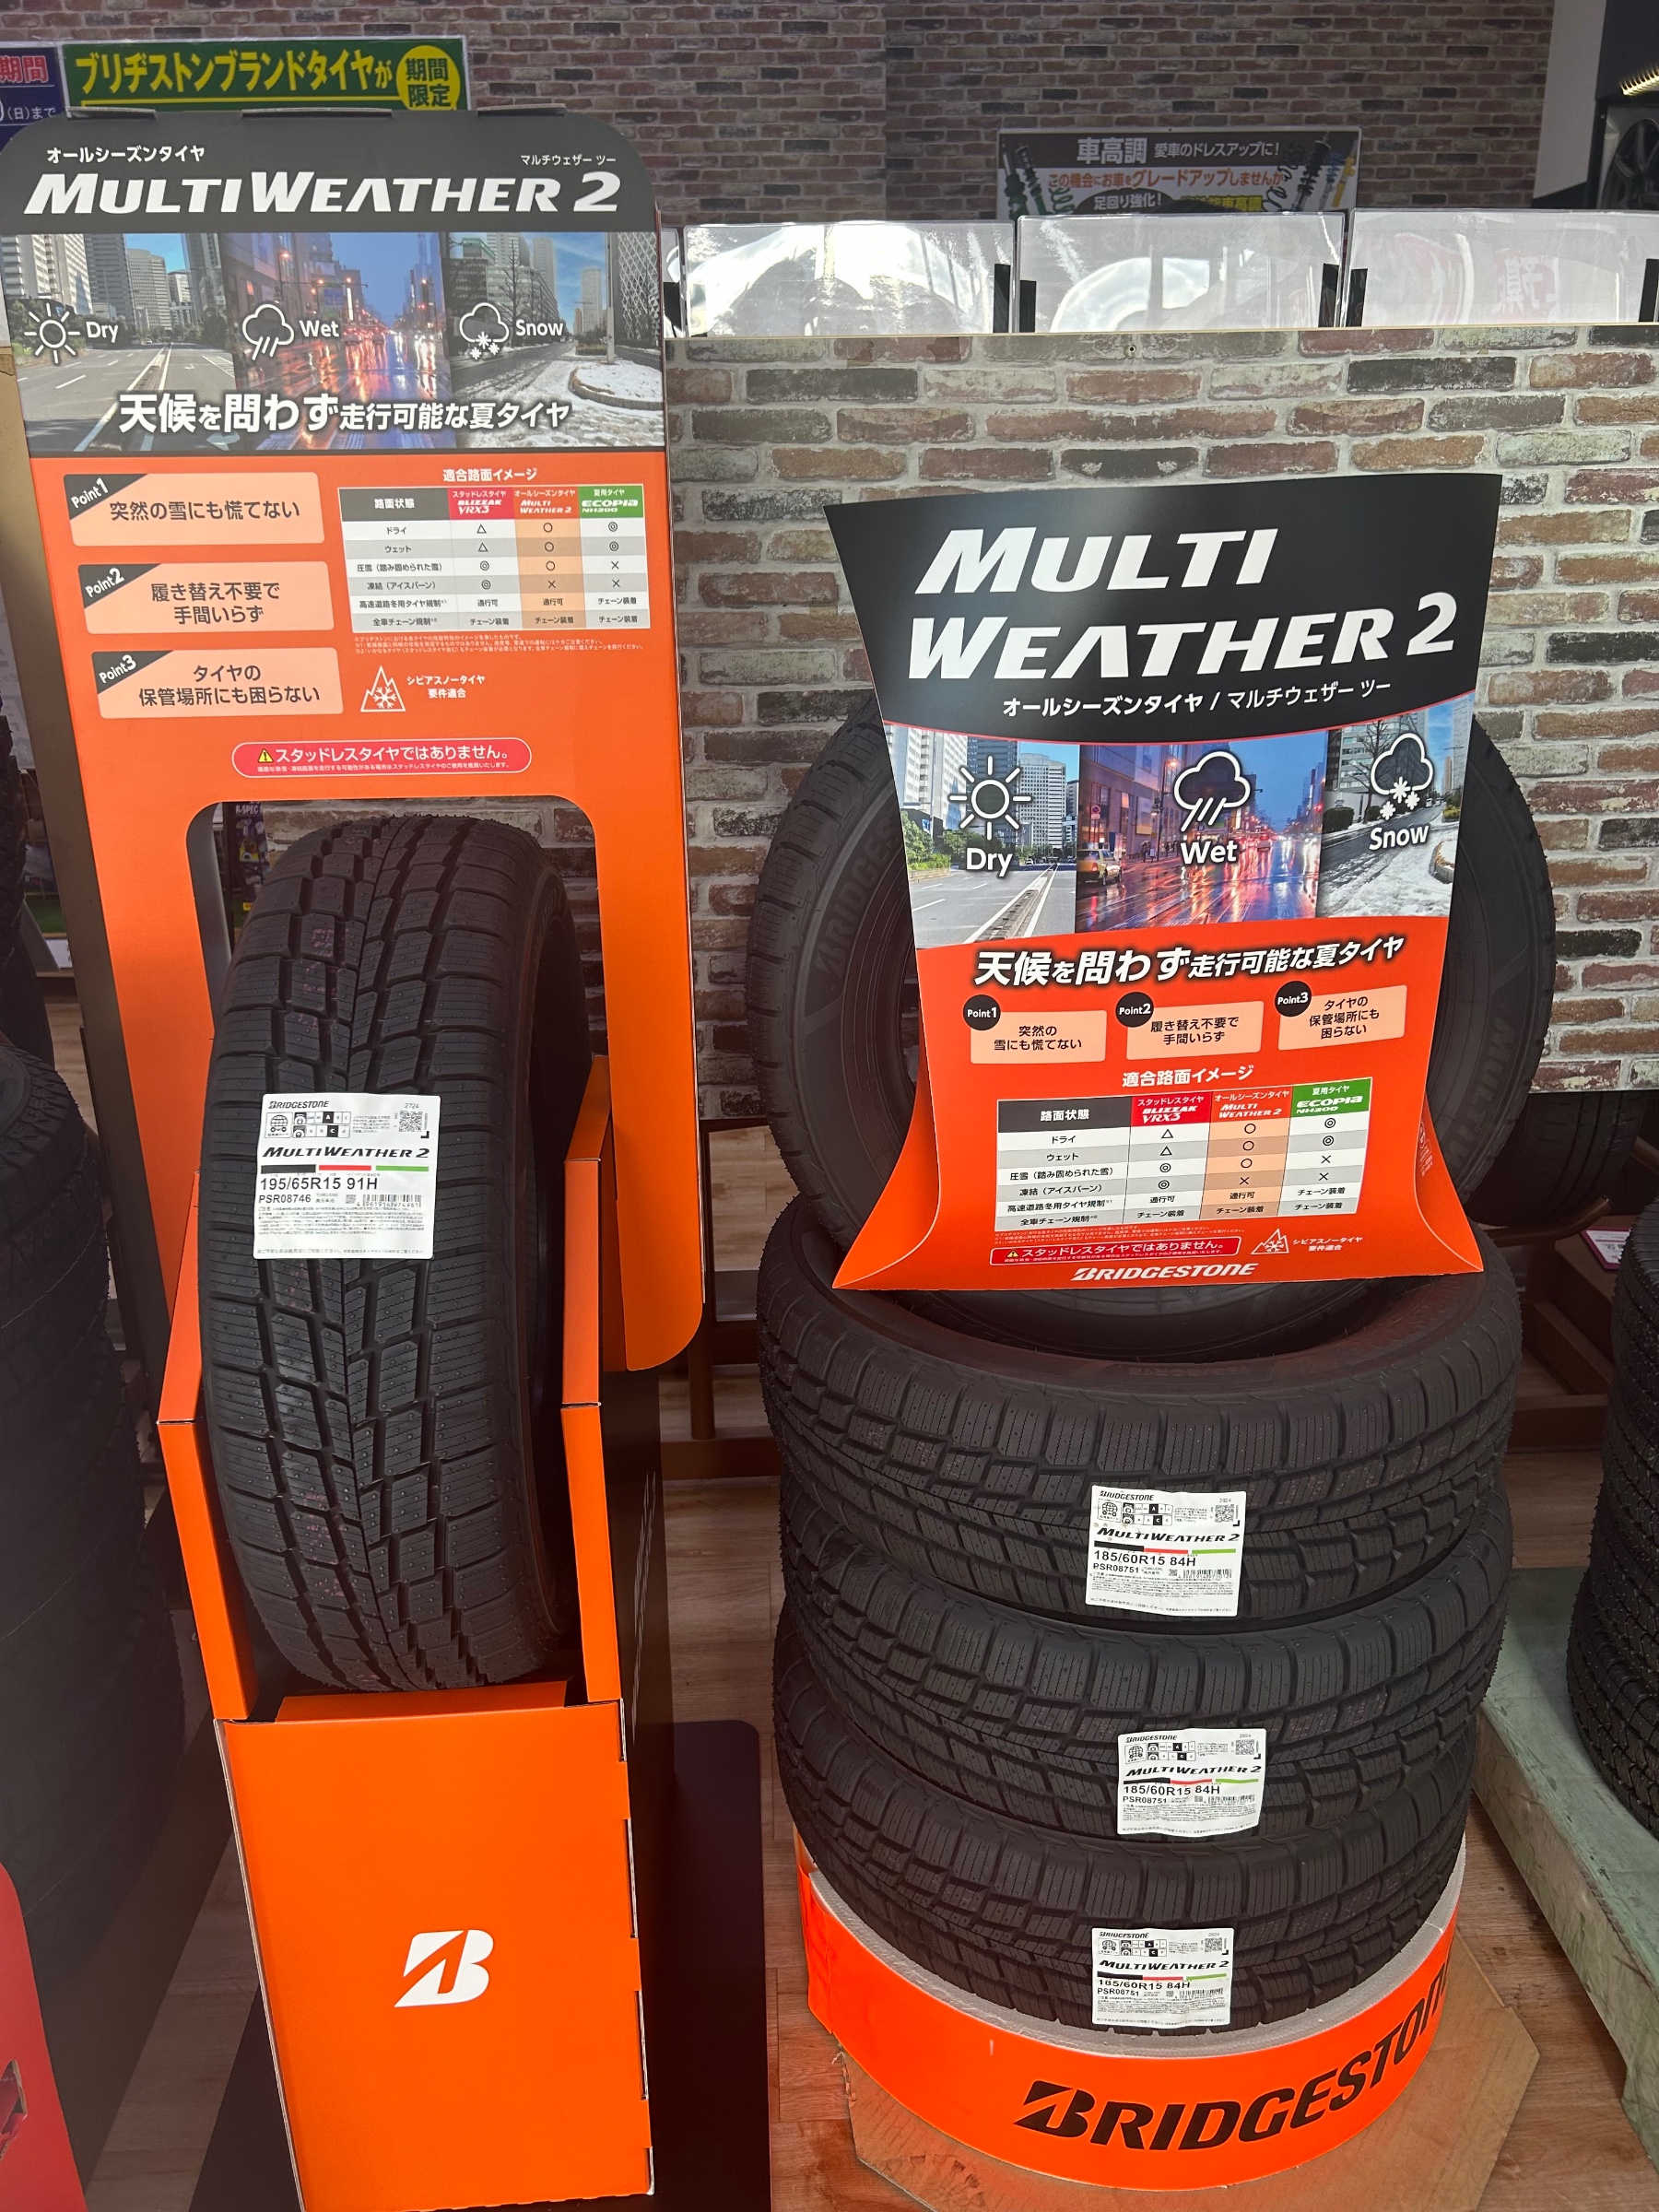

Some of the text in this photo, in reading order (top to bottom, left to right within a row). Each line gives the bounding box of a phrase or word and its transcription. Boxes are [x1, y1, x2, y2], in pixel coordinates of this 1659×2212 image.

[0, 55, 49, 83] 期間
[76, 49, 393, 94] ブリヂストンブランドタイヤが
[406, 58, 449, 81] 期間
[407, 84, 451, 108] 限定
[47, 145, 205, 163] オールシーズンタイヤ
[1077, 136, 1147, 164] 車高調
[520, 153, 617, 167] マルチウェザー ツー
[574, 171, 621, 215] 2
[86, 320, 120, 345] Dry
[300, 320, 340, 339] Wet
[515, 320, 564, 338] Snow
[118, 394, 571, 435] 天候を問わず走行可能な夏タイヤ
[442, 468, 537, 482] 適合路面イメージ
[71, 477, 110, 509] Point1
[594, 488, 625, 497] 夏用タイヤ
[374, 498, 415, 510] 路面状態
[458, 506, 489, 514] VRX3
[109, 500, 300, 522] 突然の雪にも慌てない
[386, 526, 406, 535] ドライ
[914, 526, 1278, 595] MULTI
[85, 567, 125, 598] Point2
[151, 582, 280, 602] 履き替え不要で
[477, 598, 499, 607] 通行可
[543, 597, 563, 606] 通行可
[597, 596, 637, 606] チェーン装着
[173, 606, 264, 625] 手間いらず
[535, 616, 574, 625] チェーン装着
[598, 615, 638, 623] チェーン装着
[470, 618, 510, 627] チェーン装着
[908, 591, 1458, 680] WEATHER 2
[99, 654, 137, 684] Point3
[193, 665, 261, 683] タイヤの
[406, 675, 485, 686] シビアスノータイヤ
[138, 685, 320, 707] 保管場所にも困らない
[428, 688, 466, 699] 要件適合
[1003, 692, 1204, 719] オールシーズンタイヤ
[1228, 683, 1355, 710] マルチウェザー
[1361, 679, 1391, 699] ツー
[275, 745, 508, 763] スタッドレスタイヤではありません。
[1369, 823, 1428, 852] Snow
[1181, 841, 1238, 865] Wet
[966, 847, 1013, 878] Dry
[973, 935, 1406, 986] 天候を問わず走行可能な夏タイヤ
[1277, 992, 1309, 1006] Point3
[1324, 995, 1369, 1009] タイヤの
[967, 1006, 997, 1018] Point1
[1118, 1003, 1151, 1016] Point2
[1150, 1016, 1240, 1033] 履き替え不要で
[1309, 1009, 1380, 1027] 保管場所にも
[1018, 1025, 1057, 1037] 突然の
[1163, 1030, 1225, 1045] 手間いらず
[1321, 1023, 1367, 1039] 困らない
[994, 1038, 1082, 1051] 雪にも慌てない
[1122, 1065, 1254, 1088] 適合路面イメージ
[1214, 1090, 1290, 1102] オールシーズンタイヤ
[1312, 1085, 1350, 1096] 夏用タイヤ
[268, 1100, 330, 1109] BRIDGESTONE
[1137, 1096, 1204, 1106] スタッドレスタイヤ
[1040, 1109, 1089, 1122] 路面状態
[1142, 1112, 1181, 1124] VRX3
[1218, 1109, 1272, 1118] WEATHER
[1052, 1135, 1076, 1144] ドライ
[415, 1148, 429, 1158] 2
[1046, 1153, 1078, 1162] ウェット
[260, 1177, 378, 1190] 195/65R15 91H
[1019, 1184, 1102, 1196] 凍結（アイスバーン）
[1230, 1191, 1255, 1200] 通行可
[1298, 1187, 1346, 1196] チェーン装着
[258, 1194, 312, 1204] PSR08746
[1149, 1195, 1175, 1204] 通行可
[1217, 1206, 1264, 1215] チェーン装着
[1295, 1202, 1343, 1210] チェーン装着
[1136, 1209, 1185, 1218] チェーン装着
[1293, 1236, 1363, 1245] シビアスノータイヤ
[1022, 1241, 1224, 1258] スタッドレスタイヤではありません。
[1070, 1263, 1258, 1282] BRIDGESTONE
[1100, 1490, 1155, 1500] BRIDGESTONE
[1228, 1533, 1240, 1541] 2
[1094, 1550, 1196, 1566] 185/60R15 84H
[1093, 1562, 1139, 1573] PSR08751
[1125, 1735, 1177, 1743] BRIDGESTONE
[1124, 1785, 1220, 1795] 185/60R15 84H
[1097, 1987, 1139, 1996] PSR08751
[1013, 1941, 1453, 2151] BRIDGESTON
